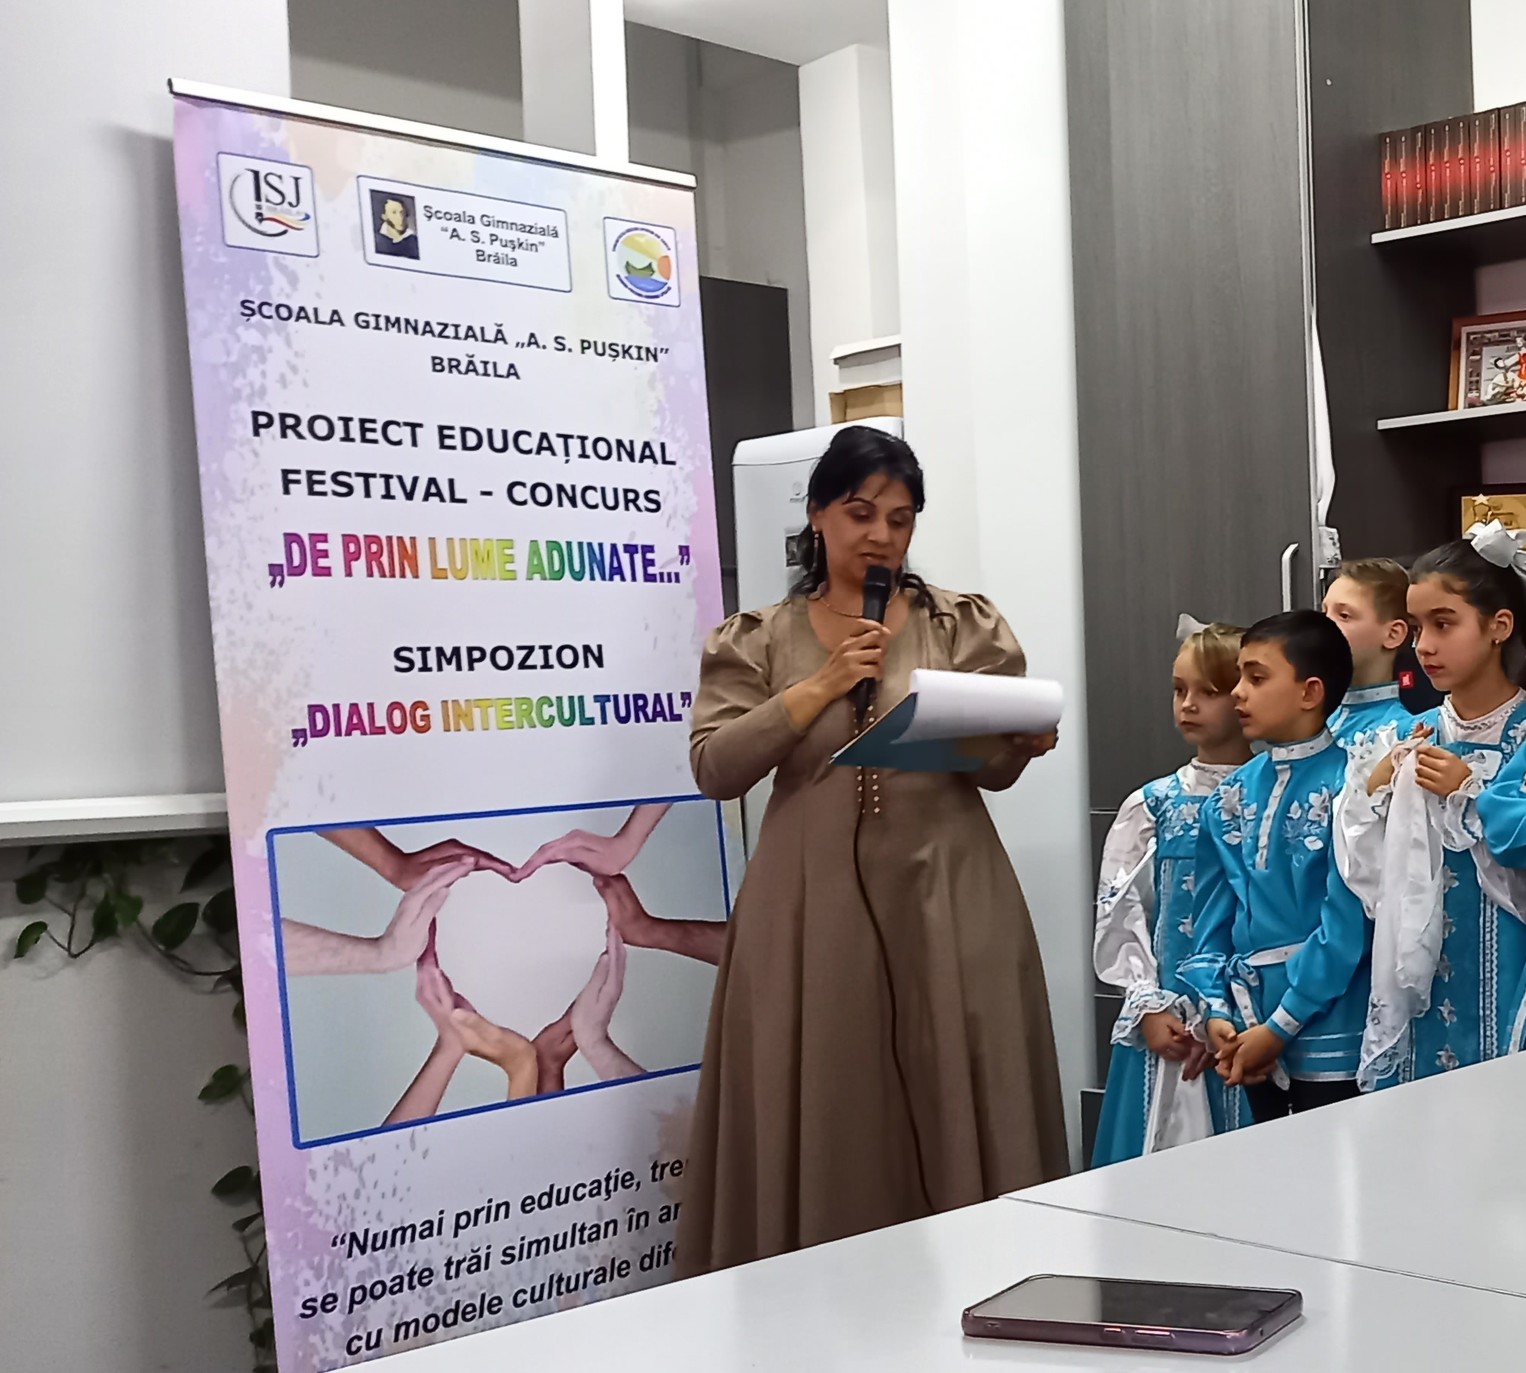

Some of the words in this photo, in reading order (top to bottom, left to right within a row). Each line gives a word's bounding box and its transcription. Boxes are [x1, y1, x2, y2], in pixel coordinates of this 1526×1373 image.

[244, 168, 303, 208] ISJ
[470, 230, 486, 244] S.
[354, 312, 508, 345] GIMNAZIALĂ
[553, 335, 573, 353] S.
[431, 353, 521, 380] BRĂILA
[251, 410, 424, 448] PROIECT
[437, 424, 677, 466] EDUCAȚIONAL
[280, 468, 468, 504] FESTIVAL
[506, 481, 662, 513] CONCURS
[341, 533, 420, 579] PRIN
[427, 536, 518, 580] LUME
[392, 643, 606, 674] SIMPOZION
[291, 700, 432, 748] „DIALOG
[441, 691, 693, 732] INTERCULTURAL”
[331, 1209, 446, 1259] “Numai
[452, 1197, 511, 1239] prin
[650, 1158, 689, 1183] tre
[299, 1291, 339, 1319] se
[347, 1262, 435, 1315] poate
[444, 1244, 492, 1281] trăi
[500, 1218, 619, 1266] simultan
[626, 1206, 650, 1233] în
[345, 1327, 384, 1356] cu
[393, 1293, 504, 1343] modele
[512, 1257, 631, 1309] culturale
[639, 1241, 677, 1273] dif
